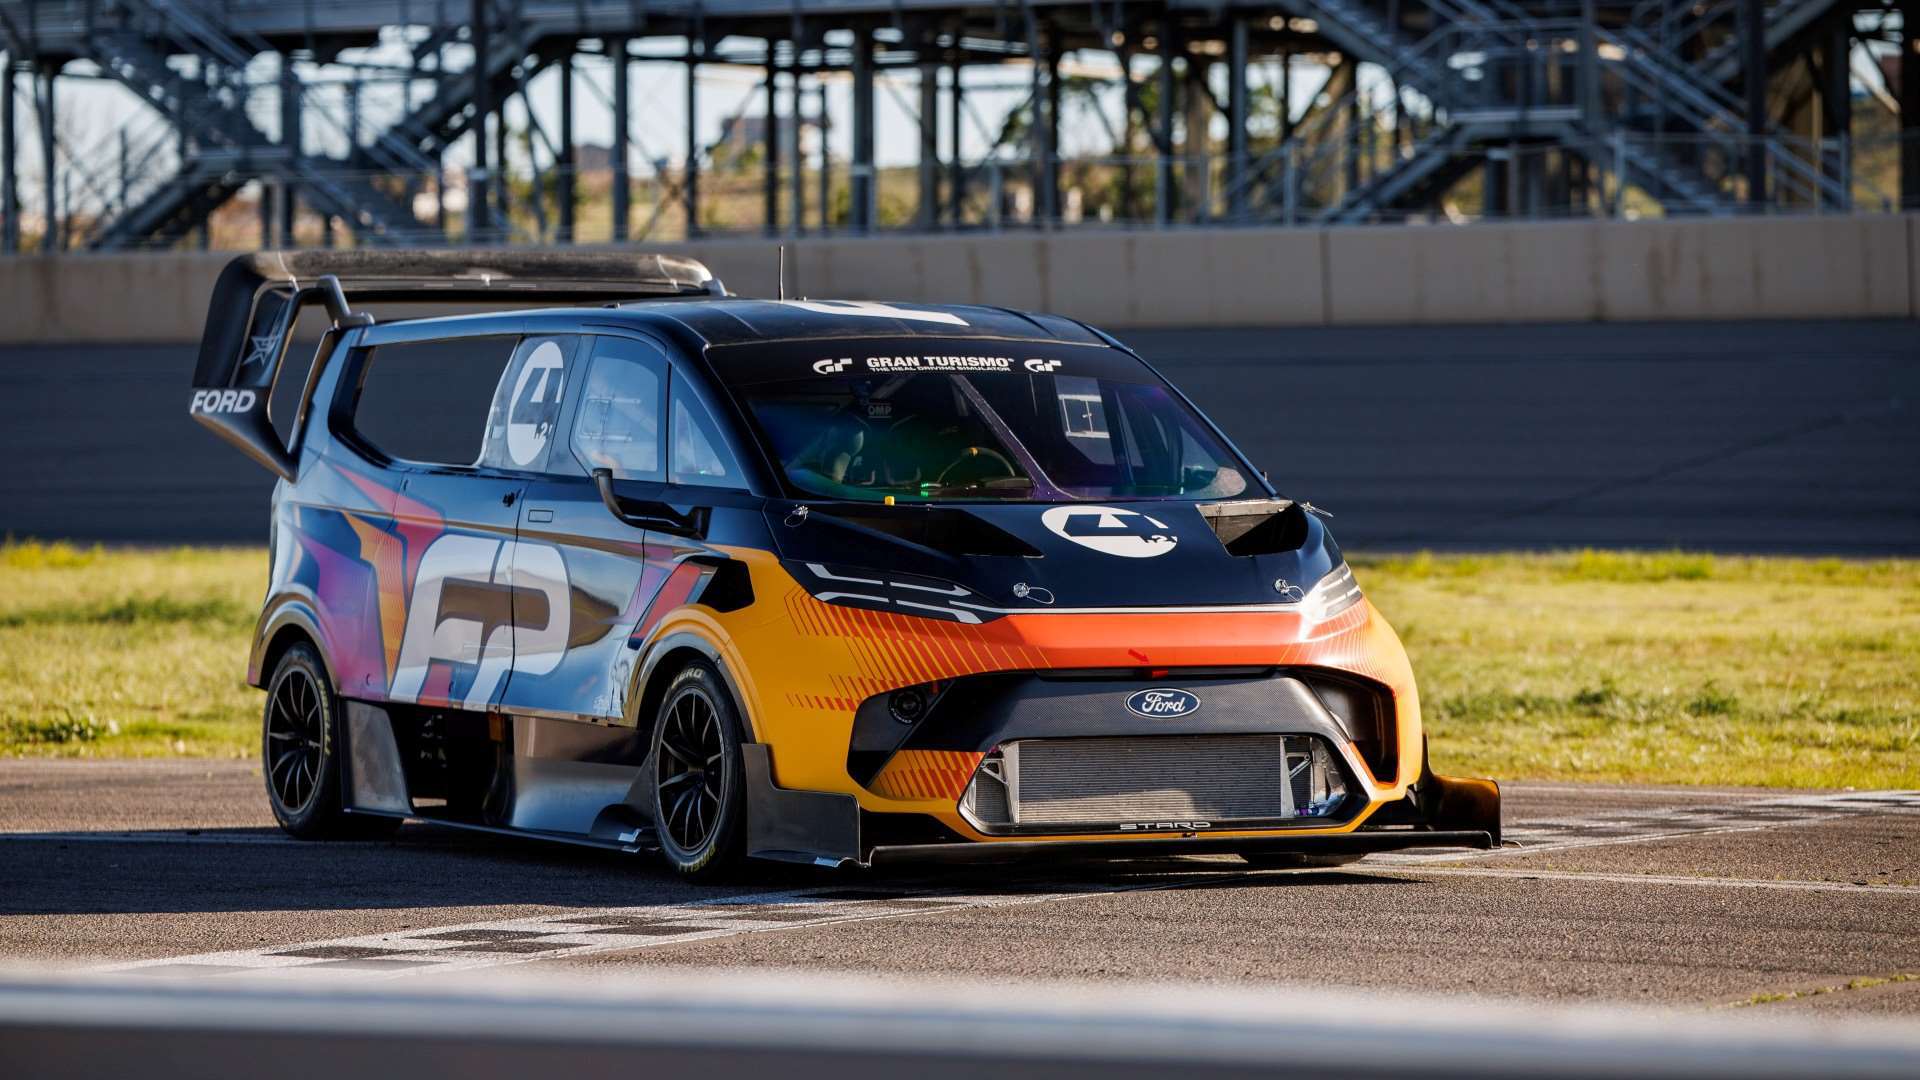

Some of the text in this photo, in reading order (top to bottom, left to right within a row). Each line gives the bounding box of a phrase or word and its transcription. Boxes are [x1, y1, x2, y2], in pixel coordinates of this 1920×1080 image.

[866, 357, 920, 368] GRAN
[190, 389, 256, 414] FORD
[868, 405, 892, 416] OMP
[1142, 692, 1186, 713] Ford
